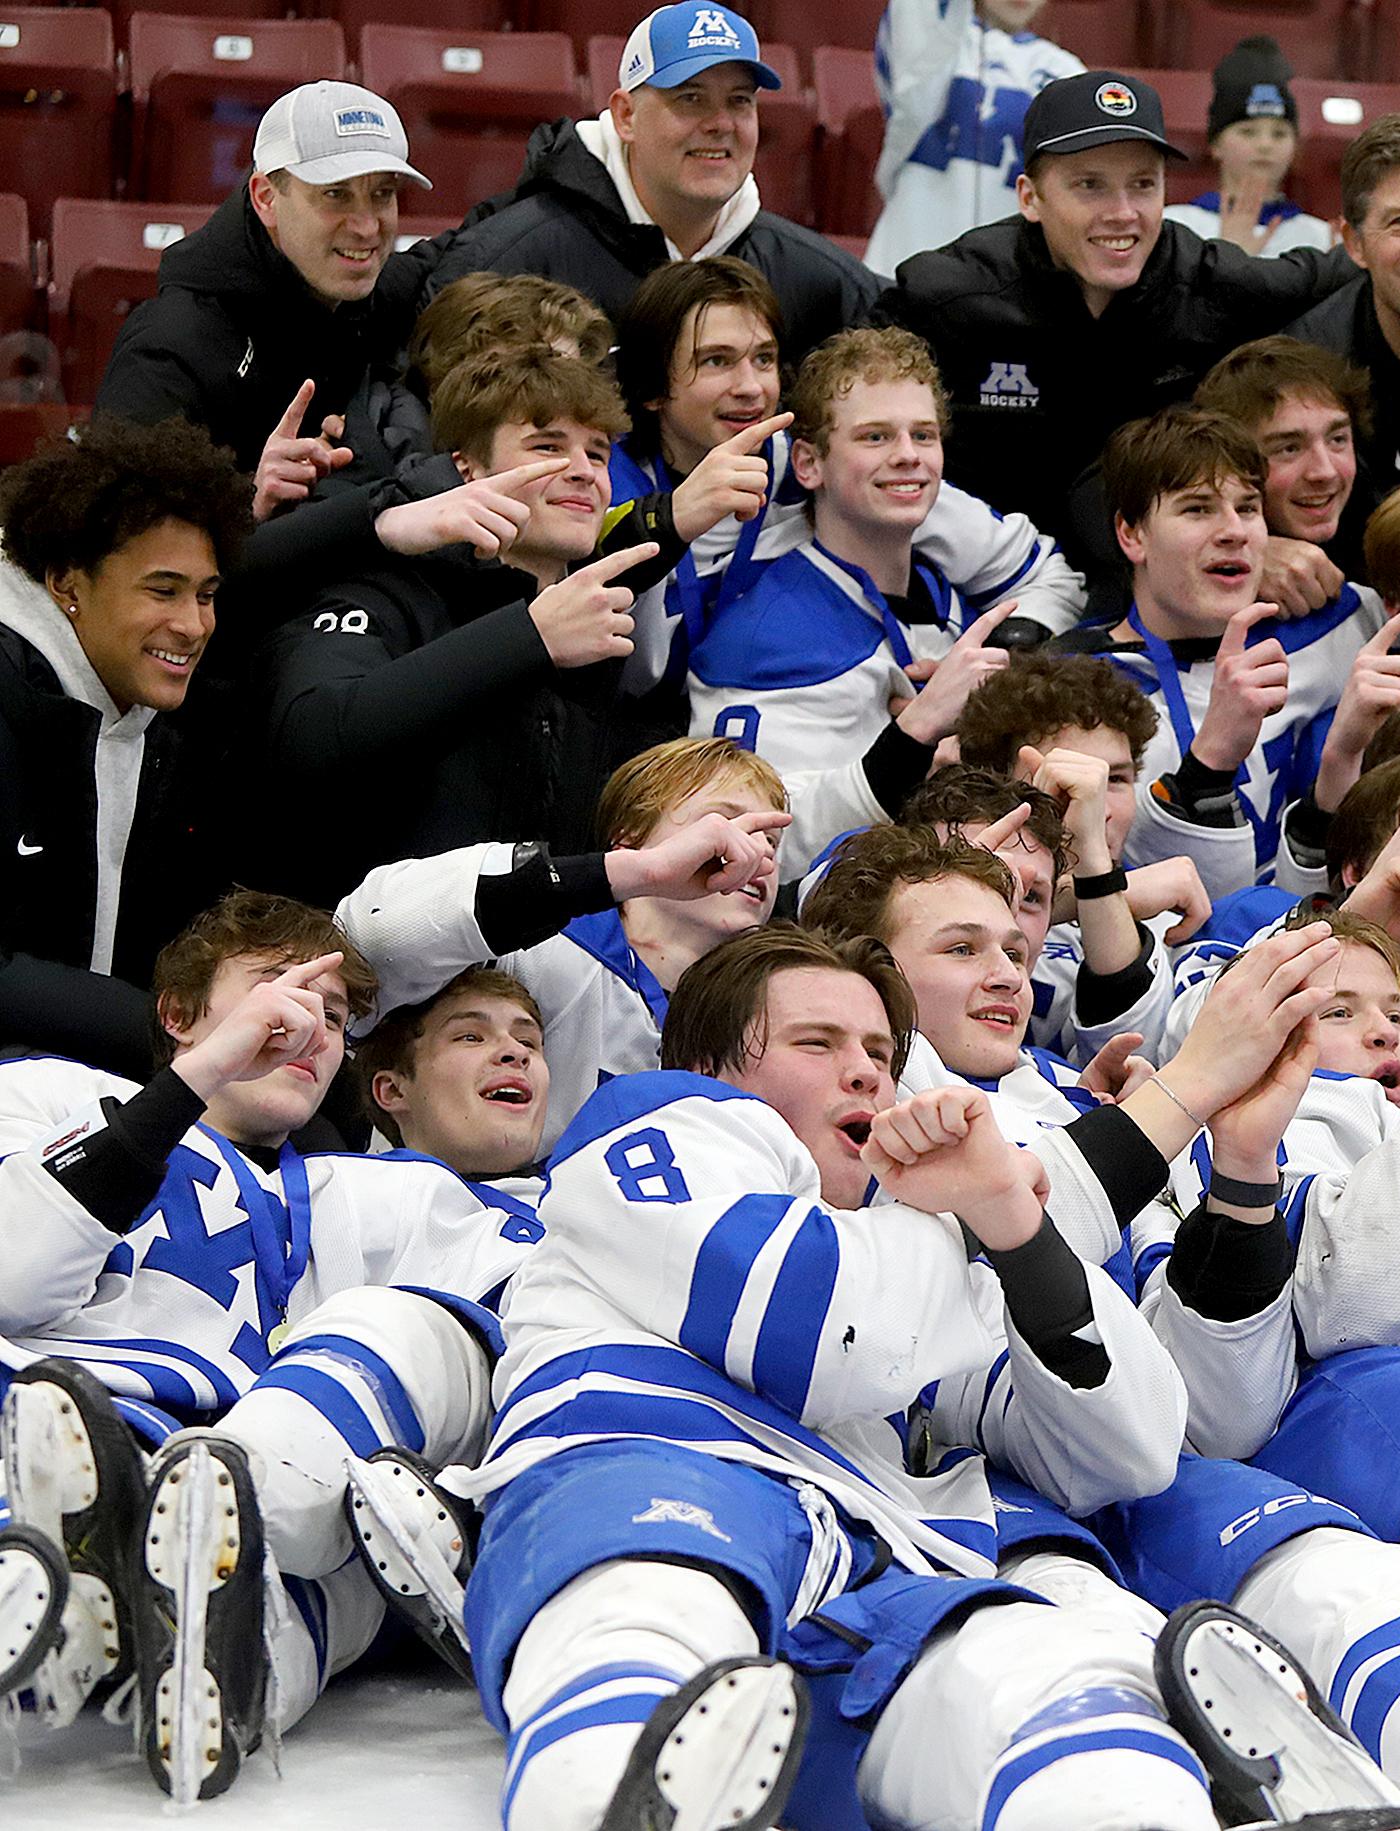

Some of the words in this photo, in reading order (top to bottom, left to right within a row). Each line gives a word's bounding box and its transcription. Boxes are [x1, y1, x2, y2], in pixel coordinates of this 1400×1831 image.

[687, 9, 739, 39] M
[687, 35, 741, 49] HOCKEY
[979, 361, 1040, 396] M
[979, 393, 1041, 408] HOCKEY
[603, 1126, 693, 1206] 8
